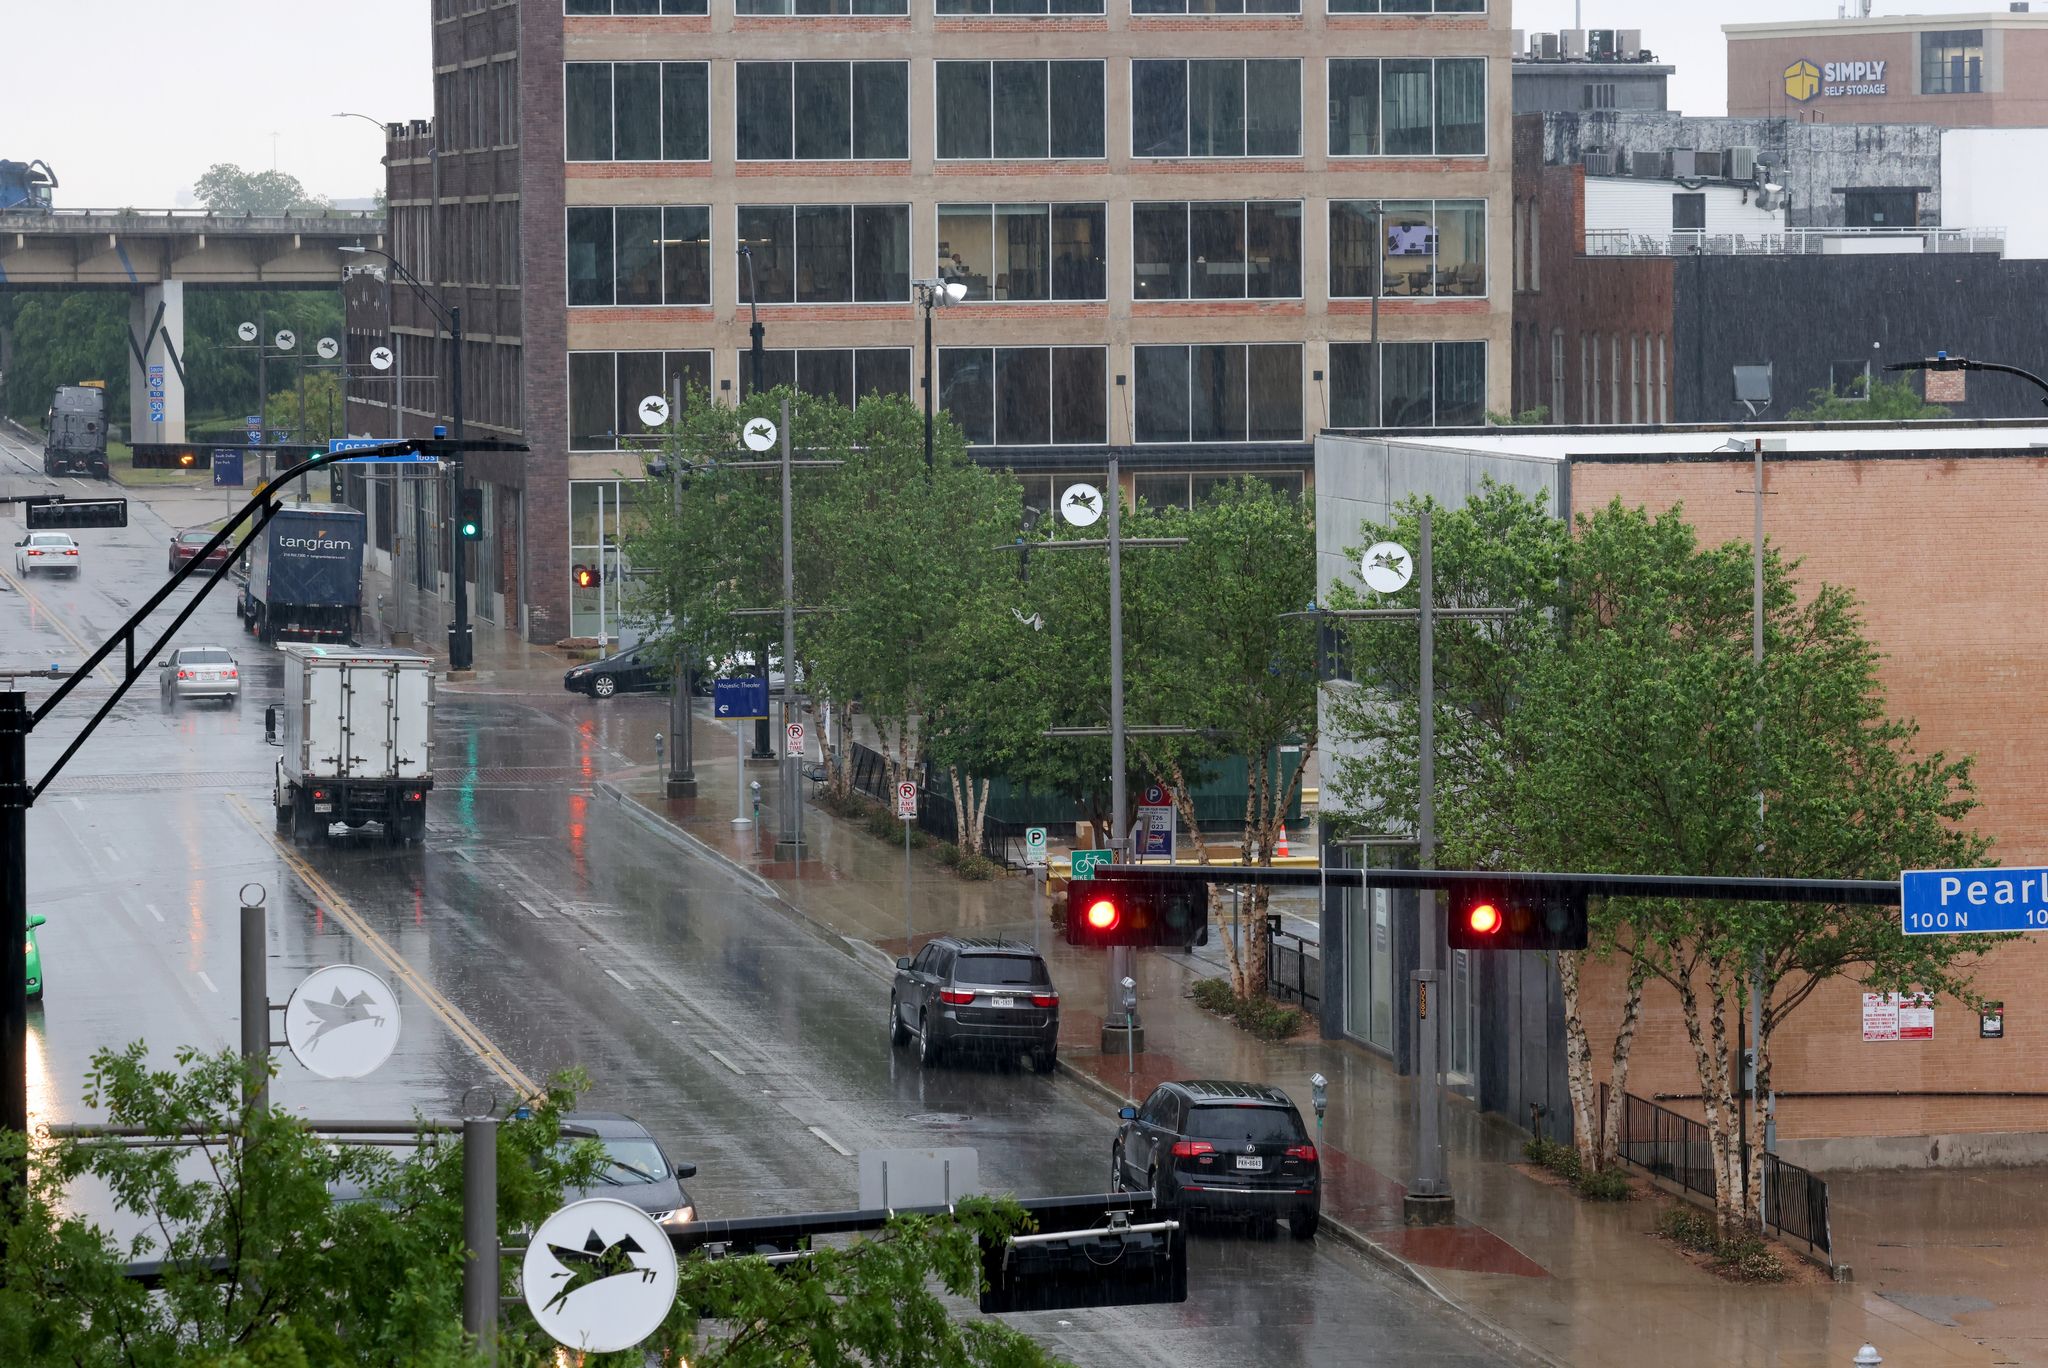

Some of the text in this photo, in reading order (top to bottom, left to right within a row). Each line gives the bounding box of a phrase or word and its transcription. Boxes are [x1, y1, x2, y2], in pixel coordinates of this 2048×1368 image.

[1824, 61, 1885, 82] SIMPLY
[1824, 84, 1886, 96] SELF STORAGE
[151, 378, 162, 386] 45
[151, 402, 162, 410] 30
[279, 535, 351, 551] tangram
[1150, 789, 1159, 800] P
[1031, 832, 1041, 844] P
[1941, 872, 2048, 906] Pearl
[1910, 912, 1968, 928] 100 N
